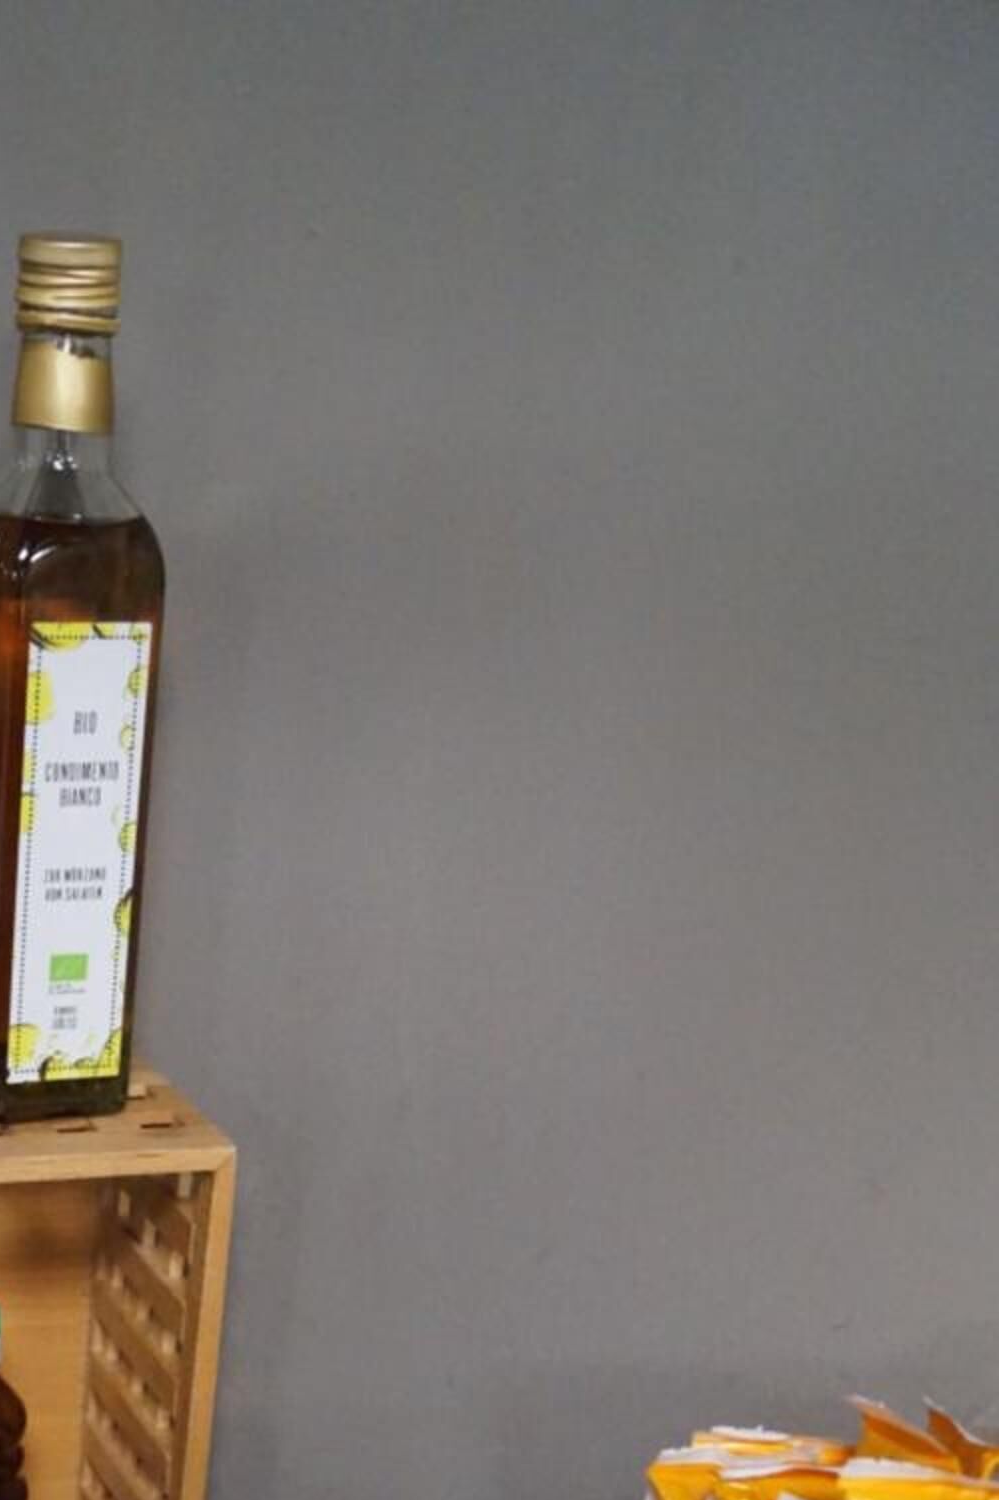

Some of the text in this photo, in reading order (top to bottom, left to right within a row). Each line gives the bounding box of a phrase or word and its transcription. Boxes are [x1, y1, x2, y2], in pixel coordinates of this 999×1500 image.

[73, 711, 98, 735] BIO
[44, 761, 120, 783] CONDIMENTO
[59, 787, 102, 808] BIANCO
